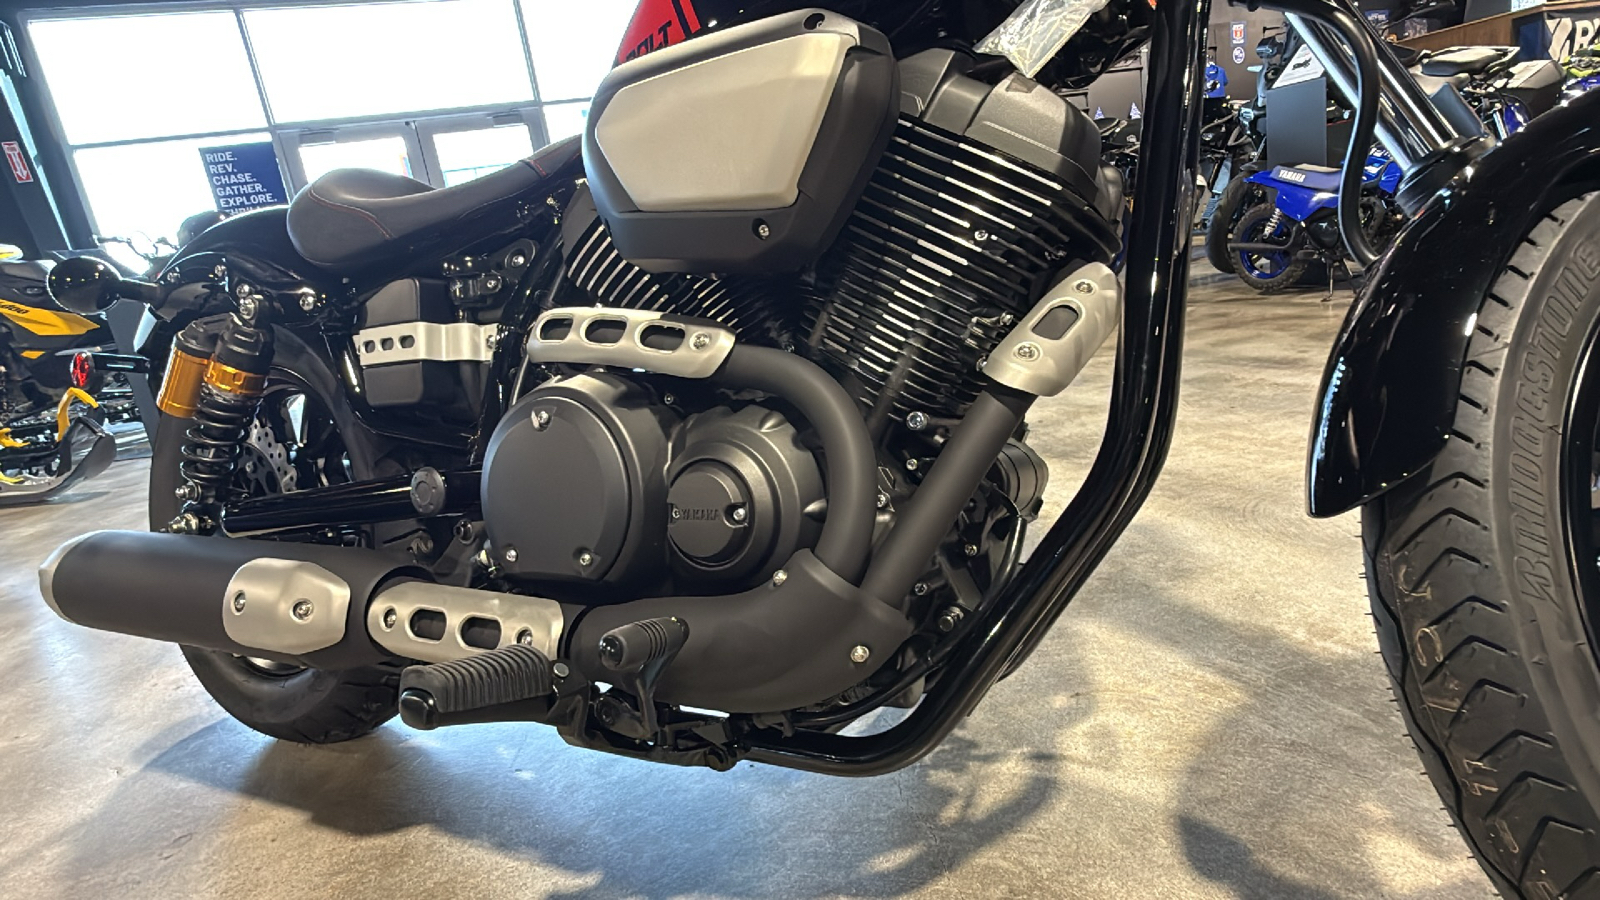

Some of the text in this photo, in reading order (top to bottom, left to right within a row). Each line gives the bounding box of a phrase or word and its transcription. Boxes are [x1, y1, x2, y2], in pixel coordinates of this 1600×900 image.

[205, 151, 237, 163] RIDE.
[209, 163, 237, 174] REV.
[212, 172, 257, 185] CHASE.
[216, 183, 267, 196] GATHER.
[219, 193, 278, 207] EXPLORE.
[1510, 240, 1600, 611] BRIDGESTONE
